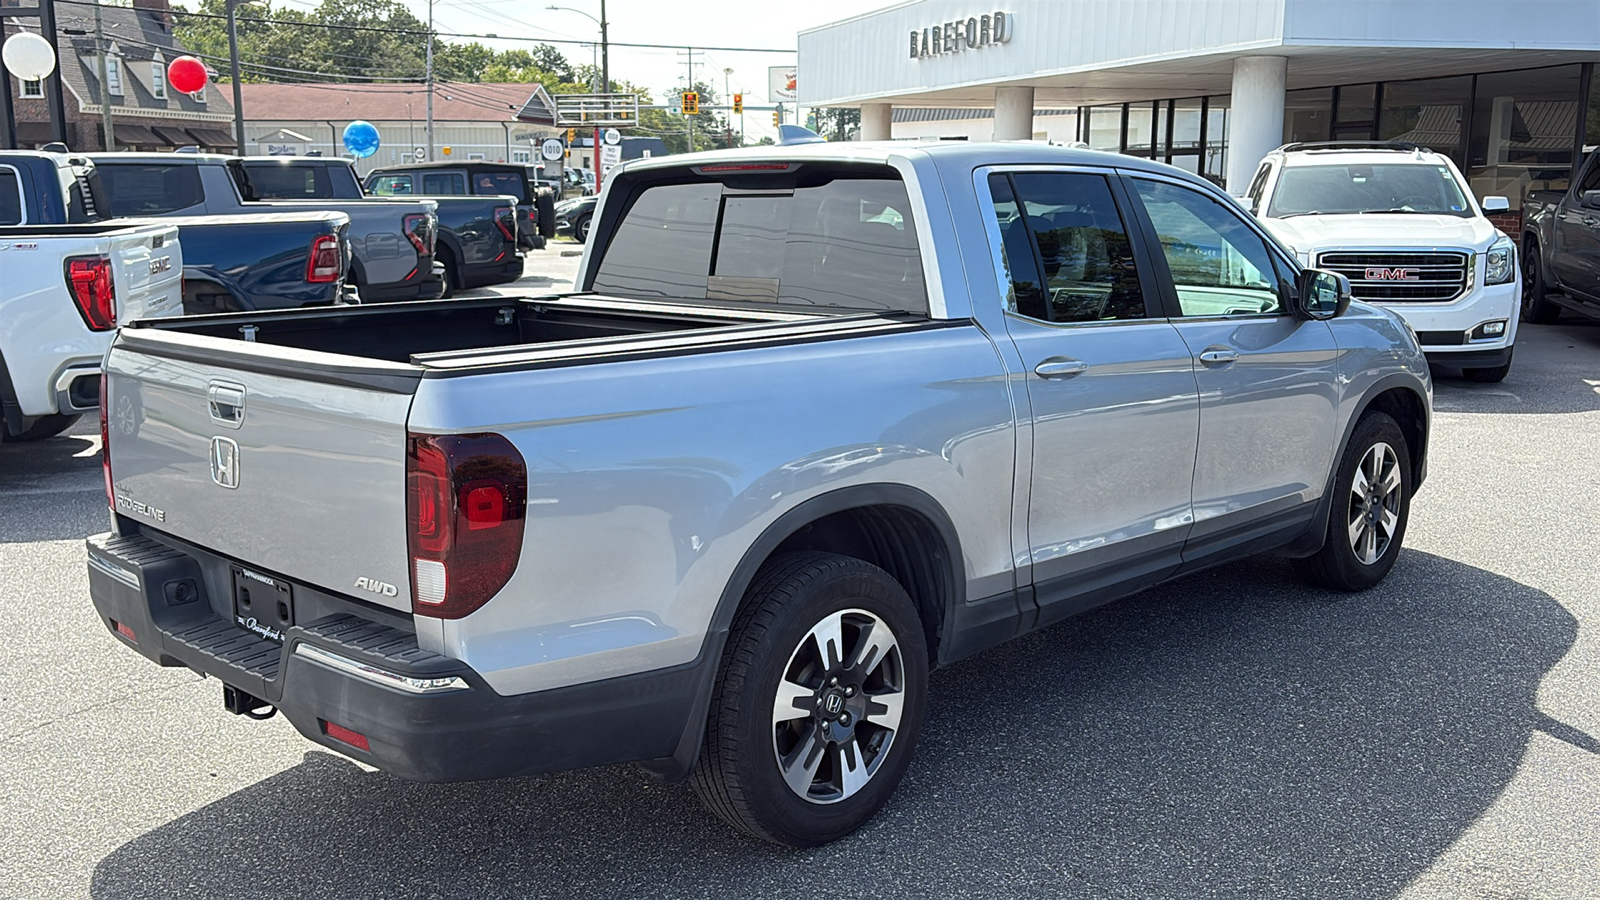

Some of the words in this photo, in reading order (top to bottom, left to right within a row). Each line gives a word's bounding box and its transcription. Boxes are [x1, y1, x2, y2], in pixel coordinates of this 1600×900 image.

[910, 11, 1012, 59] BAREFORD
[544, 145, 561, 154] 1010
[1365, 268, 1420, 280] GMC
[117, 494, 166, 522] RIDGELINE
[353, 576, 399, 598] AWD
[246, 617, 281, 639] Bareford
